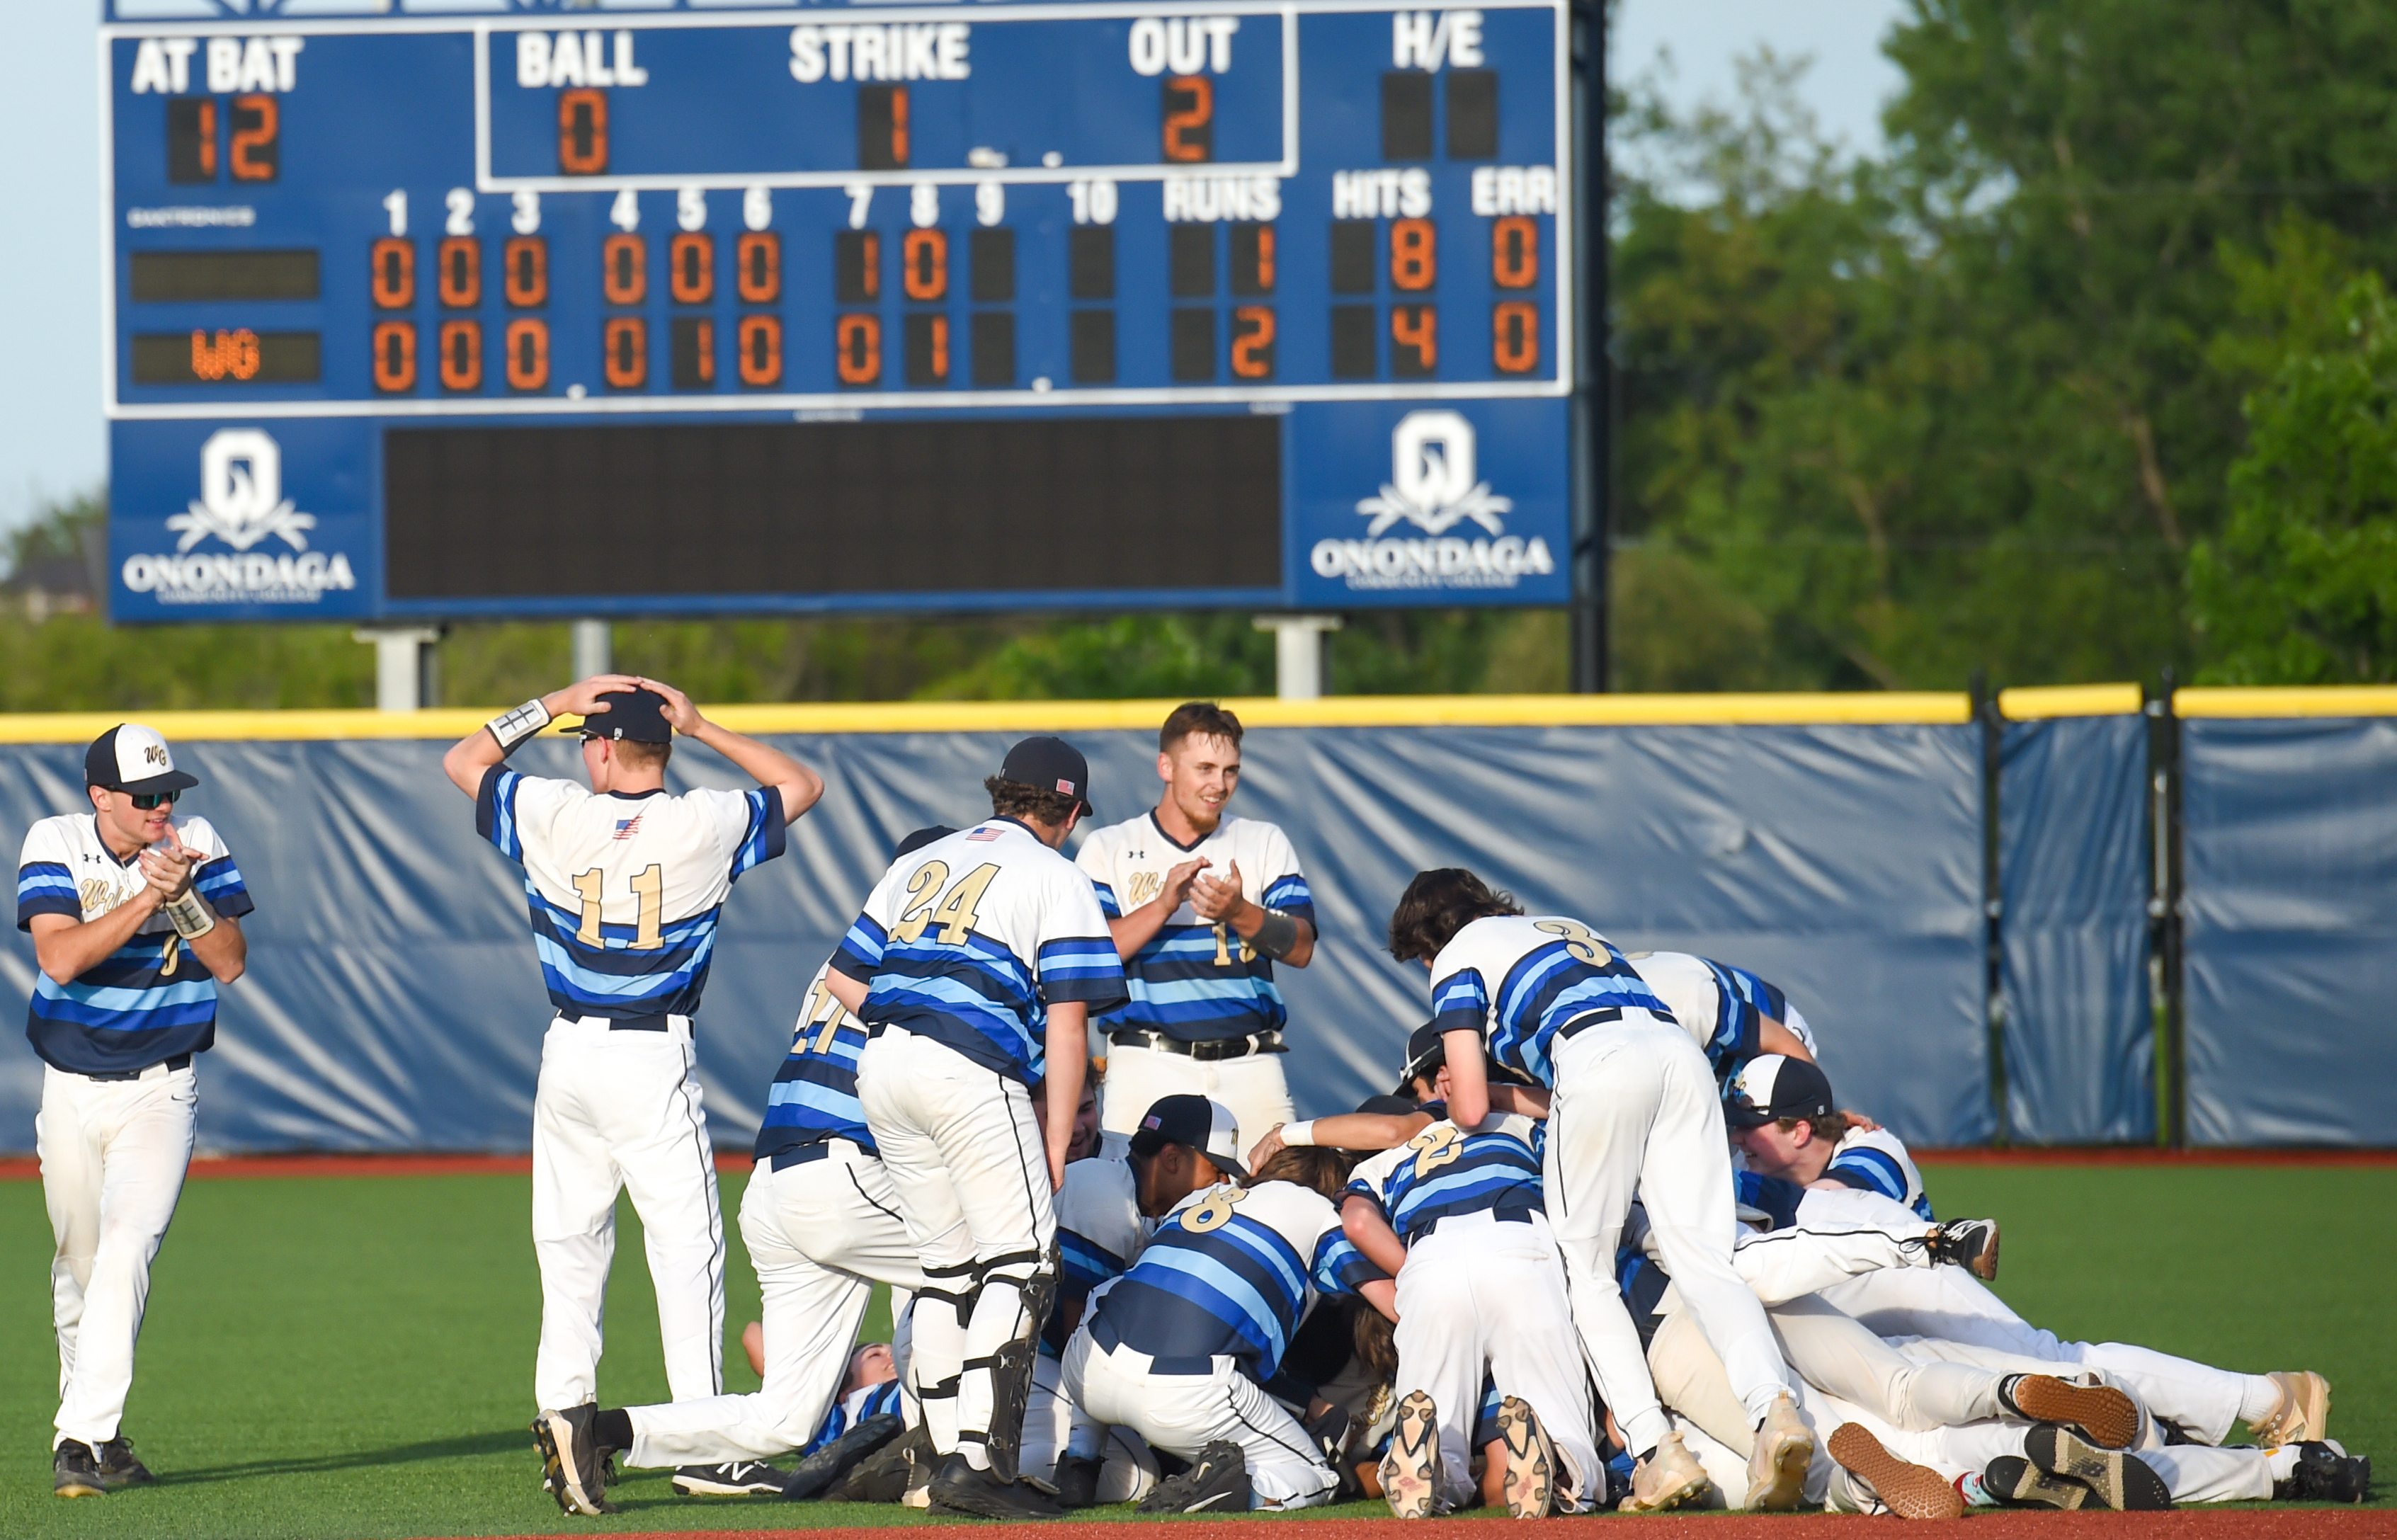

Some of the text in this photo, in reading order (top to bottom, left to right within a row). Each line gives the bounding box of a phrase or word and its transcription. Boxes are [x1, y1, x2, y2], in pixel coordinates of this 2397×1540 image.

[132, 37, 304, 93] AT BAT
[517, 30, 648, 88] BALL
[789, 24, 971, 83] STRIKE
[1128, 16, 1239, 76] OUT
[1392, 10, 1484, 73] H/E
[200, 95, 278, 179] 12
[560, 89, 608, 173] 0
[892, 87, 909, 164] 1
[1163, 75, 1212, 162] 2
[383, 181, 1118, 236] 1 2 3 4 5 6 7 8 9 10
[1163, 166, 1555, 222] RUNS HITS ERR
[372, 217, 1537, 309] 0 0 0 0 0 0 1 0 1 8 0
[374, 302, 1538, 392] 0 0 0 0 1 0 0 1 2 4 0
[122, 552, 357, 593] ONONDAGA
[1311, 537, 1554, 578] ONONDAGA
[572, 862, 666, 951] 11
[887, 859, 1001, 947] 24
[1532, 920, 1613, 968] 3
[1407, 1127, 1464, 1180] 2
